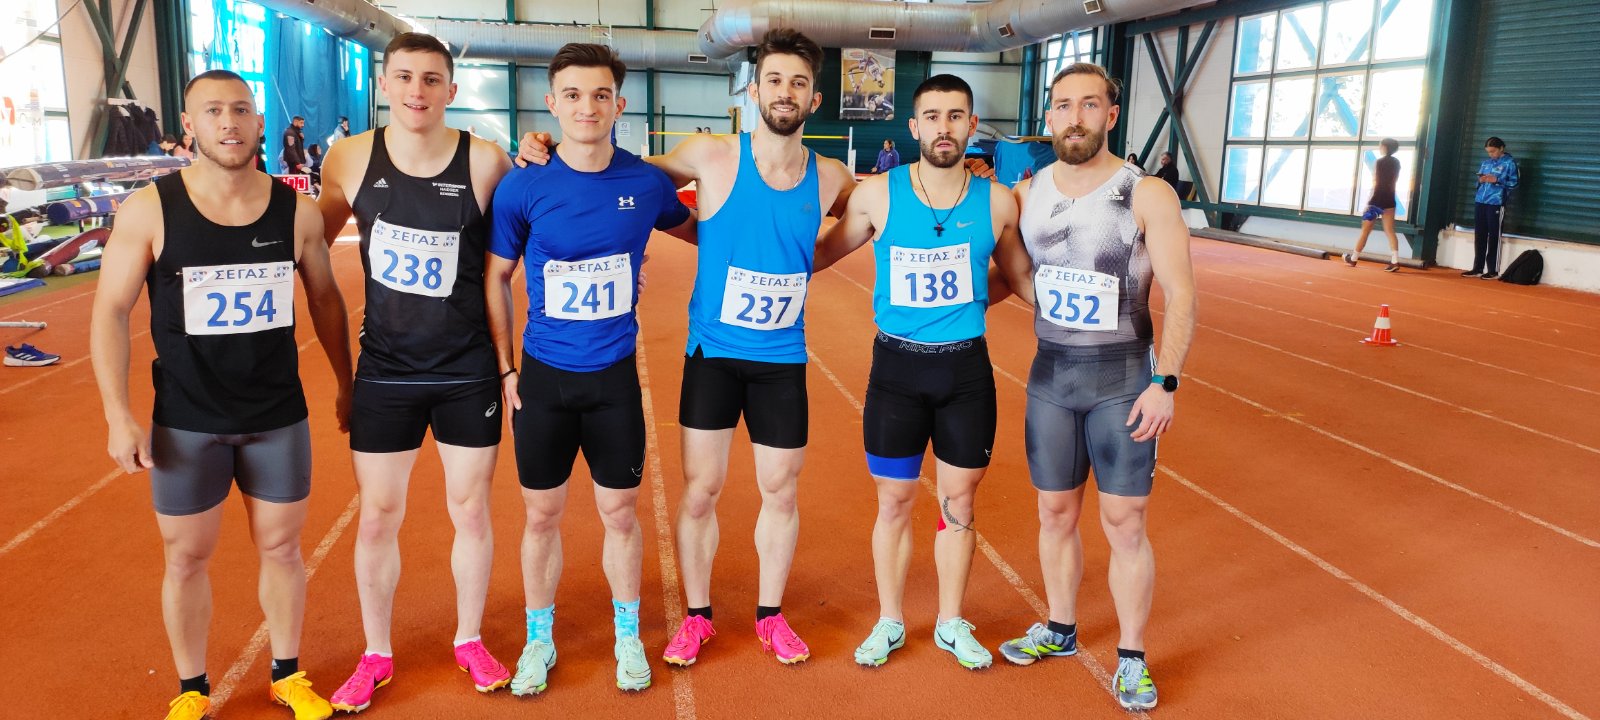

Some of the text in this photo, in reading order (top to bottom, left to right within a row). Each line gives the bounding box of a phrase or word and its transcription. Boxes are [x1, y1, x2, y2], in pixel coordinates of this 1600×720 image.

[391, 229, 439, 246] ΣΕΓΑΣ
[910, 251, 950, 263] ΣΕΓΑΣ
[215, 268, 268, 280] ΣΕΓΑΣ
[381, 249, 443, 290] 238
[568, 260, 612, 273] ΣΕΓΑΣ
[750, 275, 791, 287] ΣΕΓΑΣ
[905, 269, 959, 303] 138
[1055, 270, 1097, 285] ΣΕΓΑΣ
[561, 280, 615, 314] 241
[206, 289, 277, 328] 254
[736, 292, 793, 325] 237
[1048, 289, 1100, 325] 252
[899, 340, 973, 354] NIKE PRO
